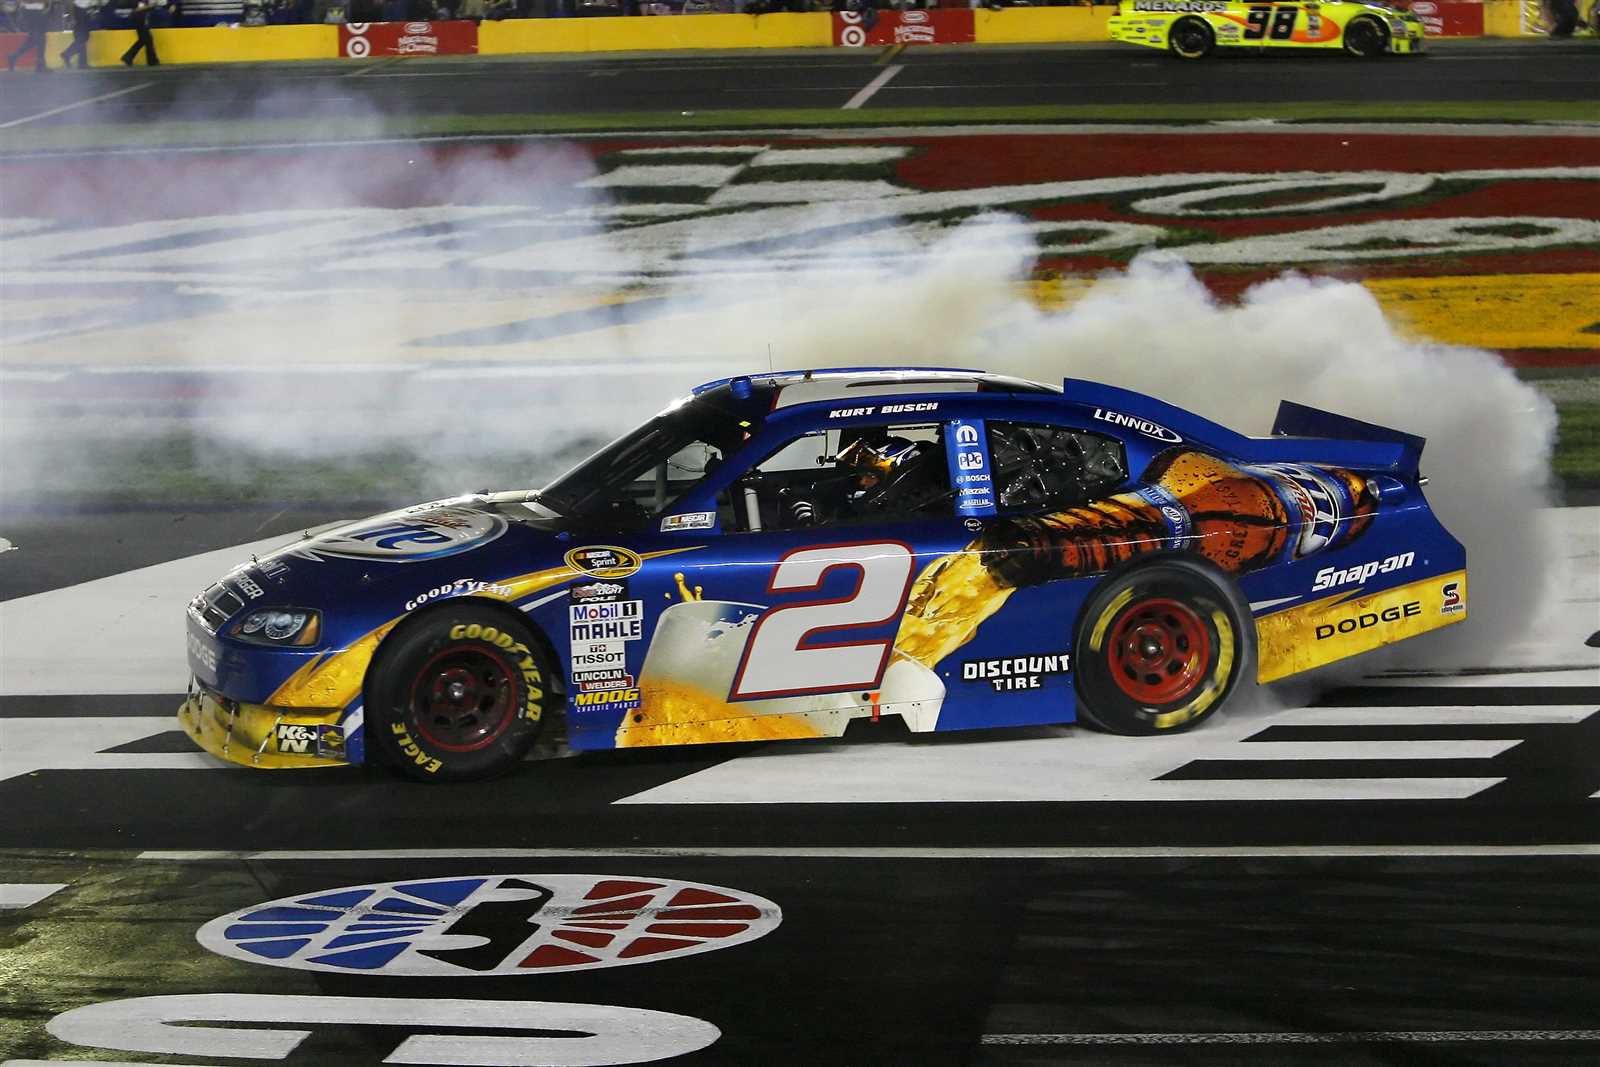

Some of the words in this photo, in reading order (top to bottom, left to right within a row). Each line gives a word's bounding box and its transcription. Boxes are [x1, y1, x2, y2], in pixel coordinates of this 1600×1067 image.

[1134, 0, 1226, 12] MENARDS
[1244, 6, 1298, 39] 98
[829, 407, 876, 418] KURT
[881, 402, 939, 414] BUSCH
[1093, 408, 1164, 438] LENNOX
[960, 453, 982, 467] PPG
[965, 474, 991, 482] BOSCH
[591, 557, 617, 568] Sprint
[1312, 552, 1415, 592] Snap-on
[405, 578, 513, 611] GOODYEAR
[580, 595, 616, 603] POLE
[574, 604, 618, 620] Mobil
[728, 540, 916, 702] 2
[1315, 601, 1422, 641] DODGE
[572, 621, 640, 640] MAHLE
[573, 653, 624, 664] TISSOT
[450, 624, 543, 722] GOODYEAR
[963, 655, 1070, 679] DISCOUNT
[575, 670, 622, 682] LINCOLN
[992, 676, 1041, 691] TIRE
[585, 681, 628, 690] WELDERS
[575, 689, 640, 705] MOOG
[613, 701, 639, 709] PARTS
[391, 722, 443, 773] EAGLE
